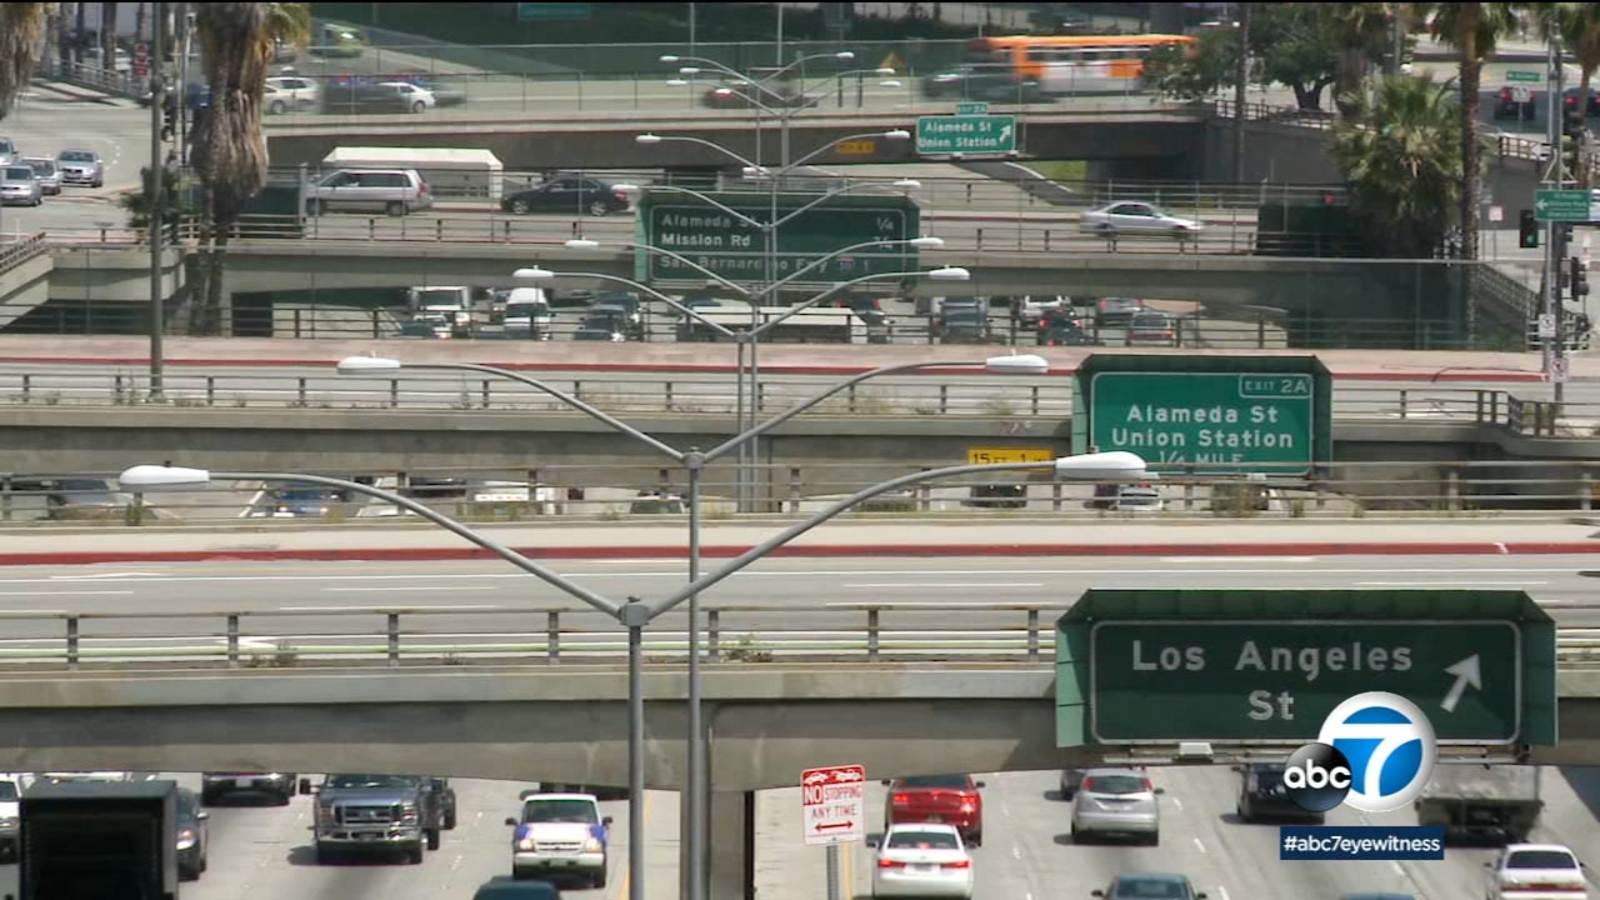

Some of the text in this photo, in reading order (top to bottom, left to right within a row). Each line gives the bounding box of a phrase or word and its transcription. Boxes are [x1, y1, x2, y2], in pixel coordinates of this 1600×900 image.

[925, 121, 991, 132] Alameda St
[919, 136, 998, 148] Union Station
[661, 214, 731, 228] Alameda
[661, 233, 722, 246] Mission
[730, 234, 751, 247] Rd
[1244, 379, 1308, 393] EXIT 2A
[1126, 404, 1279, 423] Alameda St
[1112, 428, 1293, 448] Union Station
[1132, 640, 1412, 681] Los Angeles
[1248, 689, 1295, 722] St
[804, 785, 862, 805] NO STOPPING
[812, 804, 857, 819] ANY TIME
